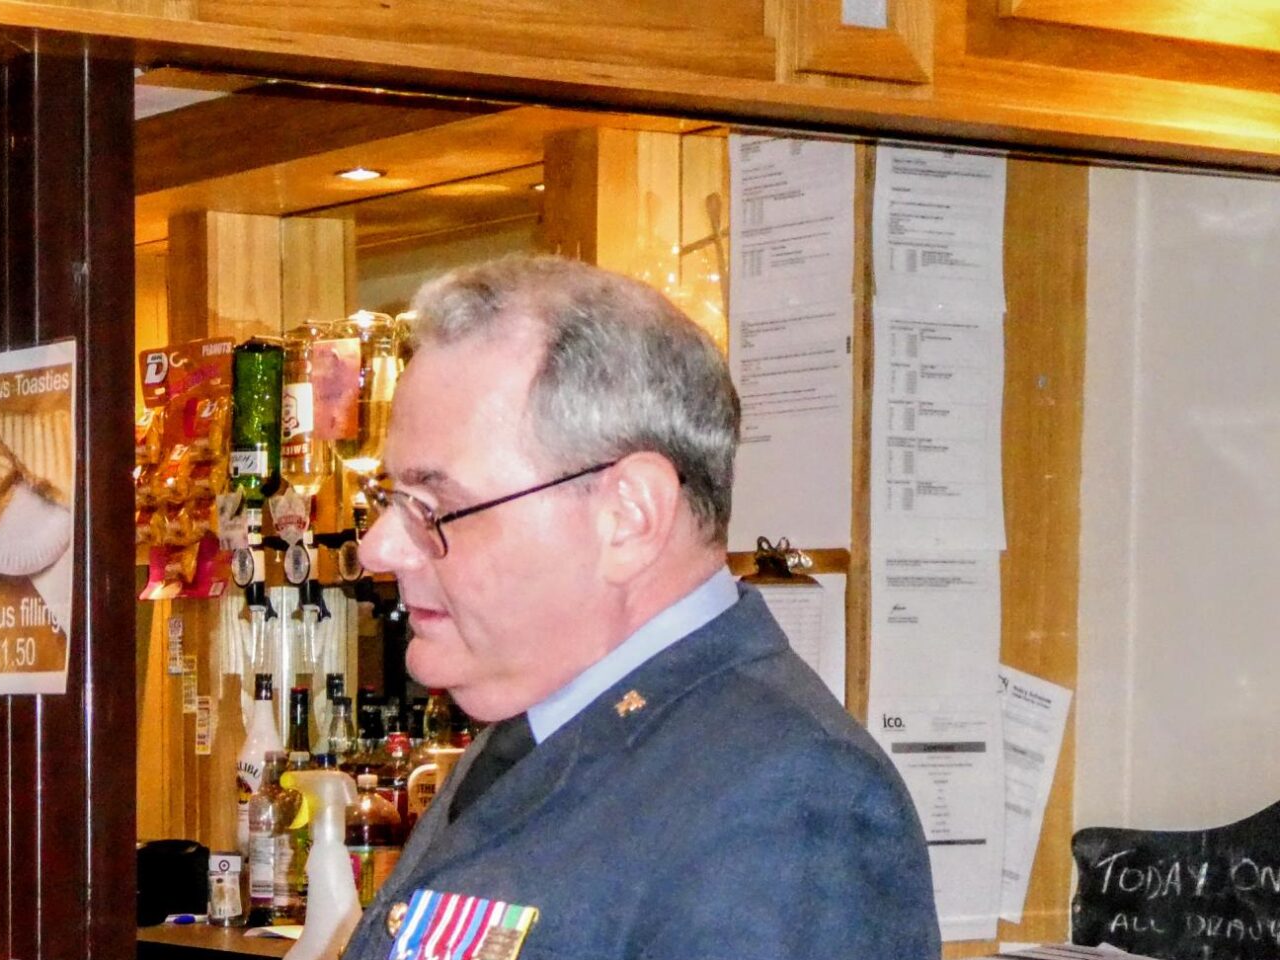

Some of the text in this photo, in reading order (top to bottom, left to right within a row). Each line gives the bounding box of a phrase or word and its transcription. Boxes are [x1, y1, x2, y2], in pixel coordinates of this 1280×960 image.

[15, 371, 69, 396] Toasties
[1095, 849, 1208, 900] TODAY
[1110, 912, 1165, 933] ALL
